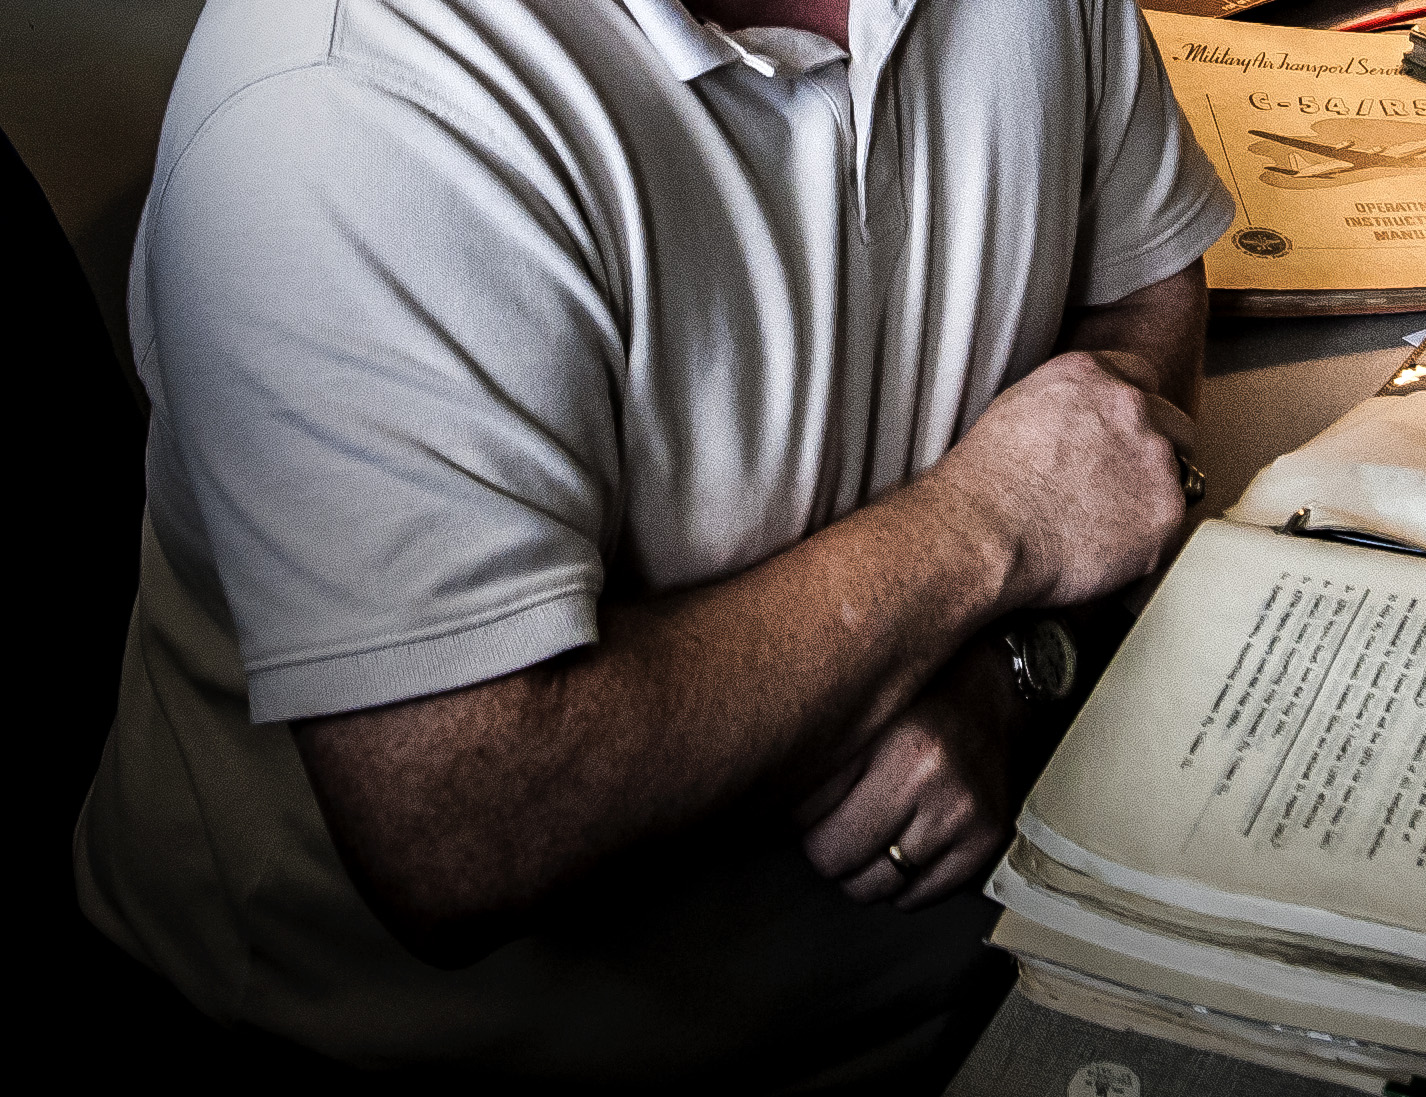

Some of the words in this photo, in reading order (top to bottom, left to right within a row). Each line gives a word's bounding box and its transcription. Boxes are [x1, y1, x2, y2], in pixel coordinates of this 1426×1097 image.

[1182, 42, 1251, 73] Military
[1251, 51, 1275, 70] Air
[1276, 52, 1355, 78] Transport
